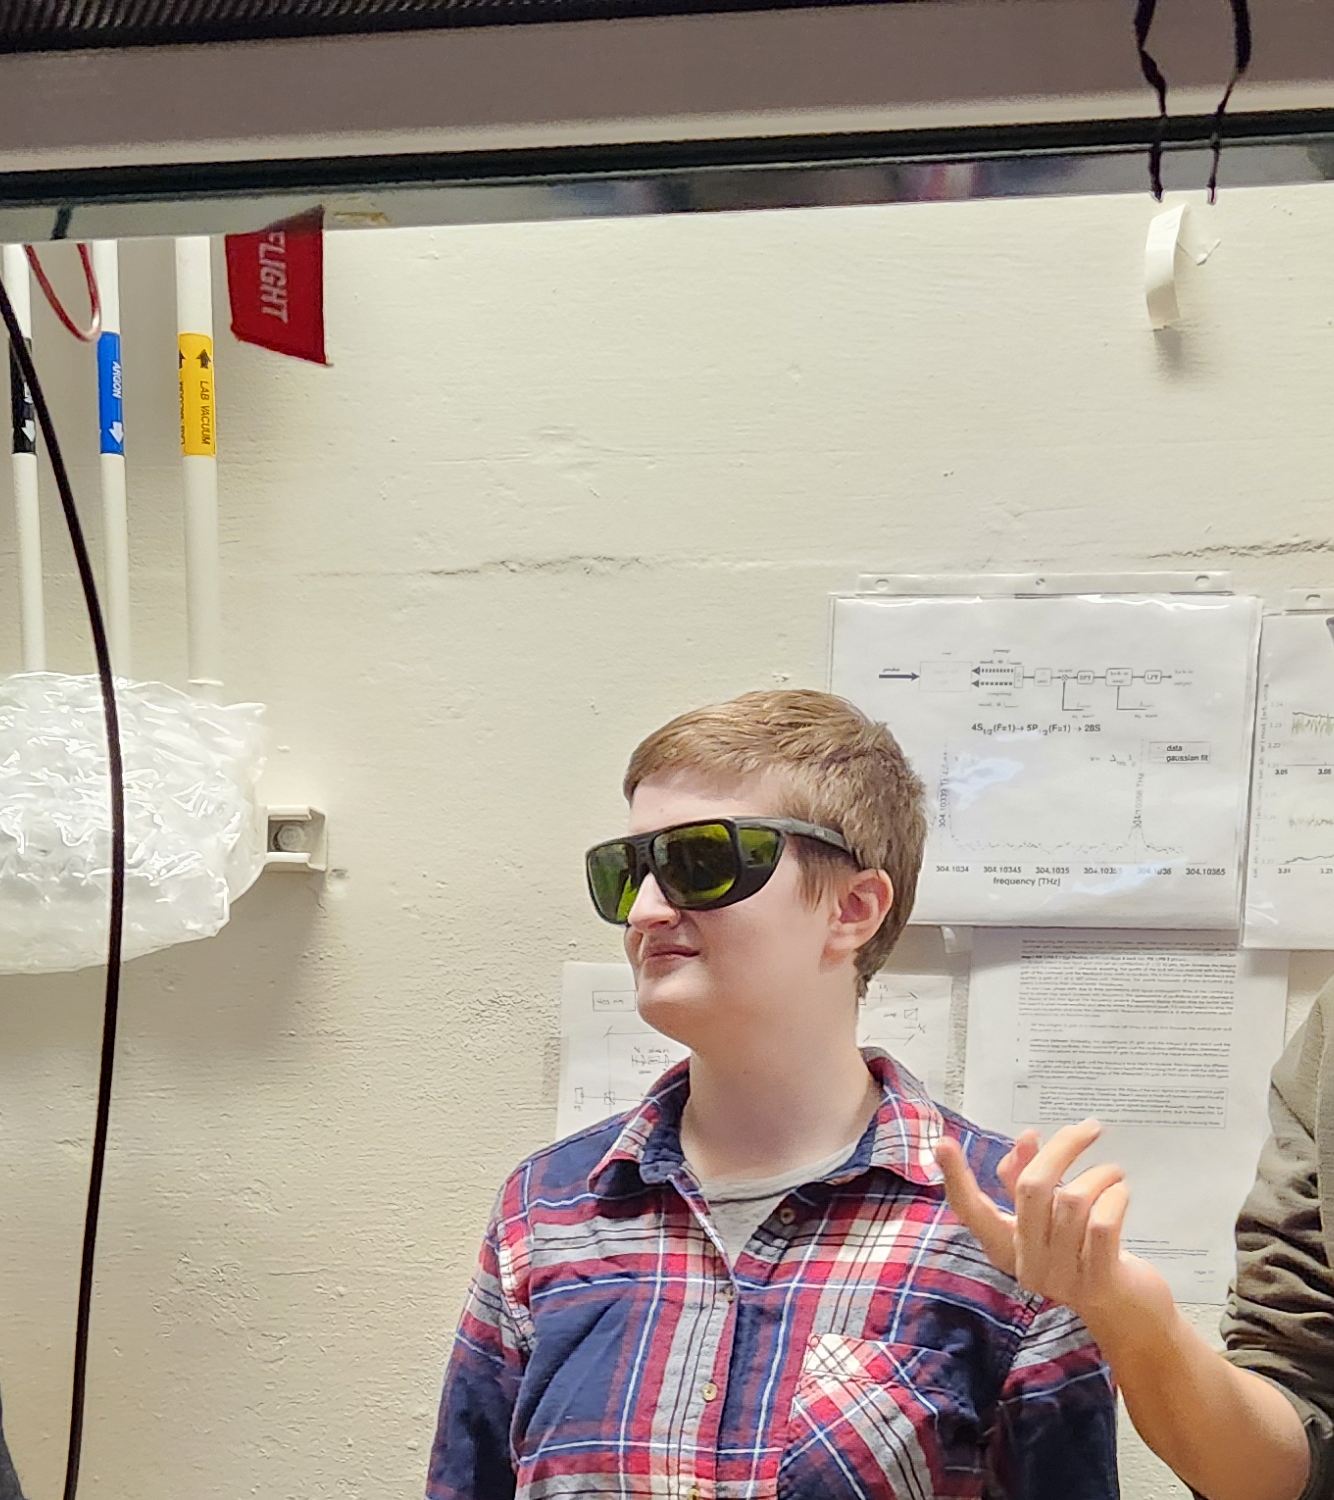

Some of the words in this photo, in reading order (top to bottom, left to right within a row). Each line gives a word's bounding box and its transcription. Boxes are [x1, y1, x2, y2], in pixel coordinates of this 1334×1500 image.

[110, 361, 122, 400] ARGON
[200, 380, 211, 400] LAB
[200, 405, 212, 445] VACUUM
[993, 877, 1036, 886] frequency
